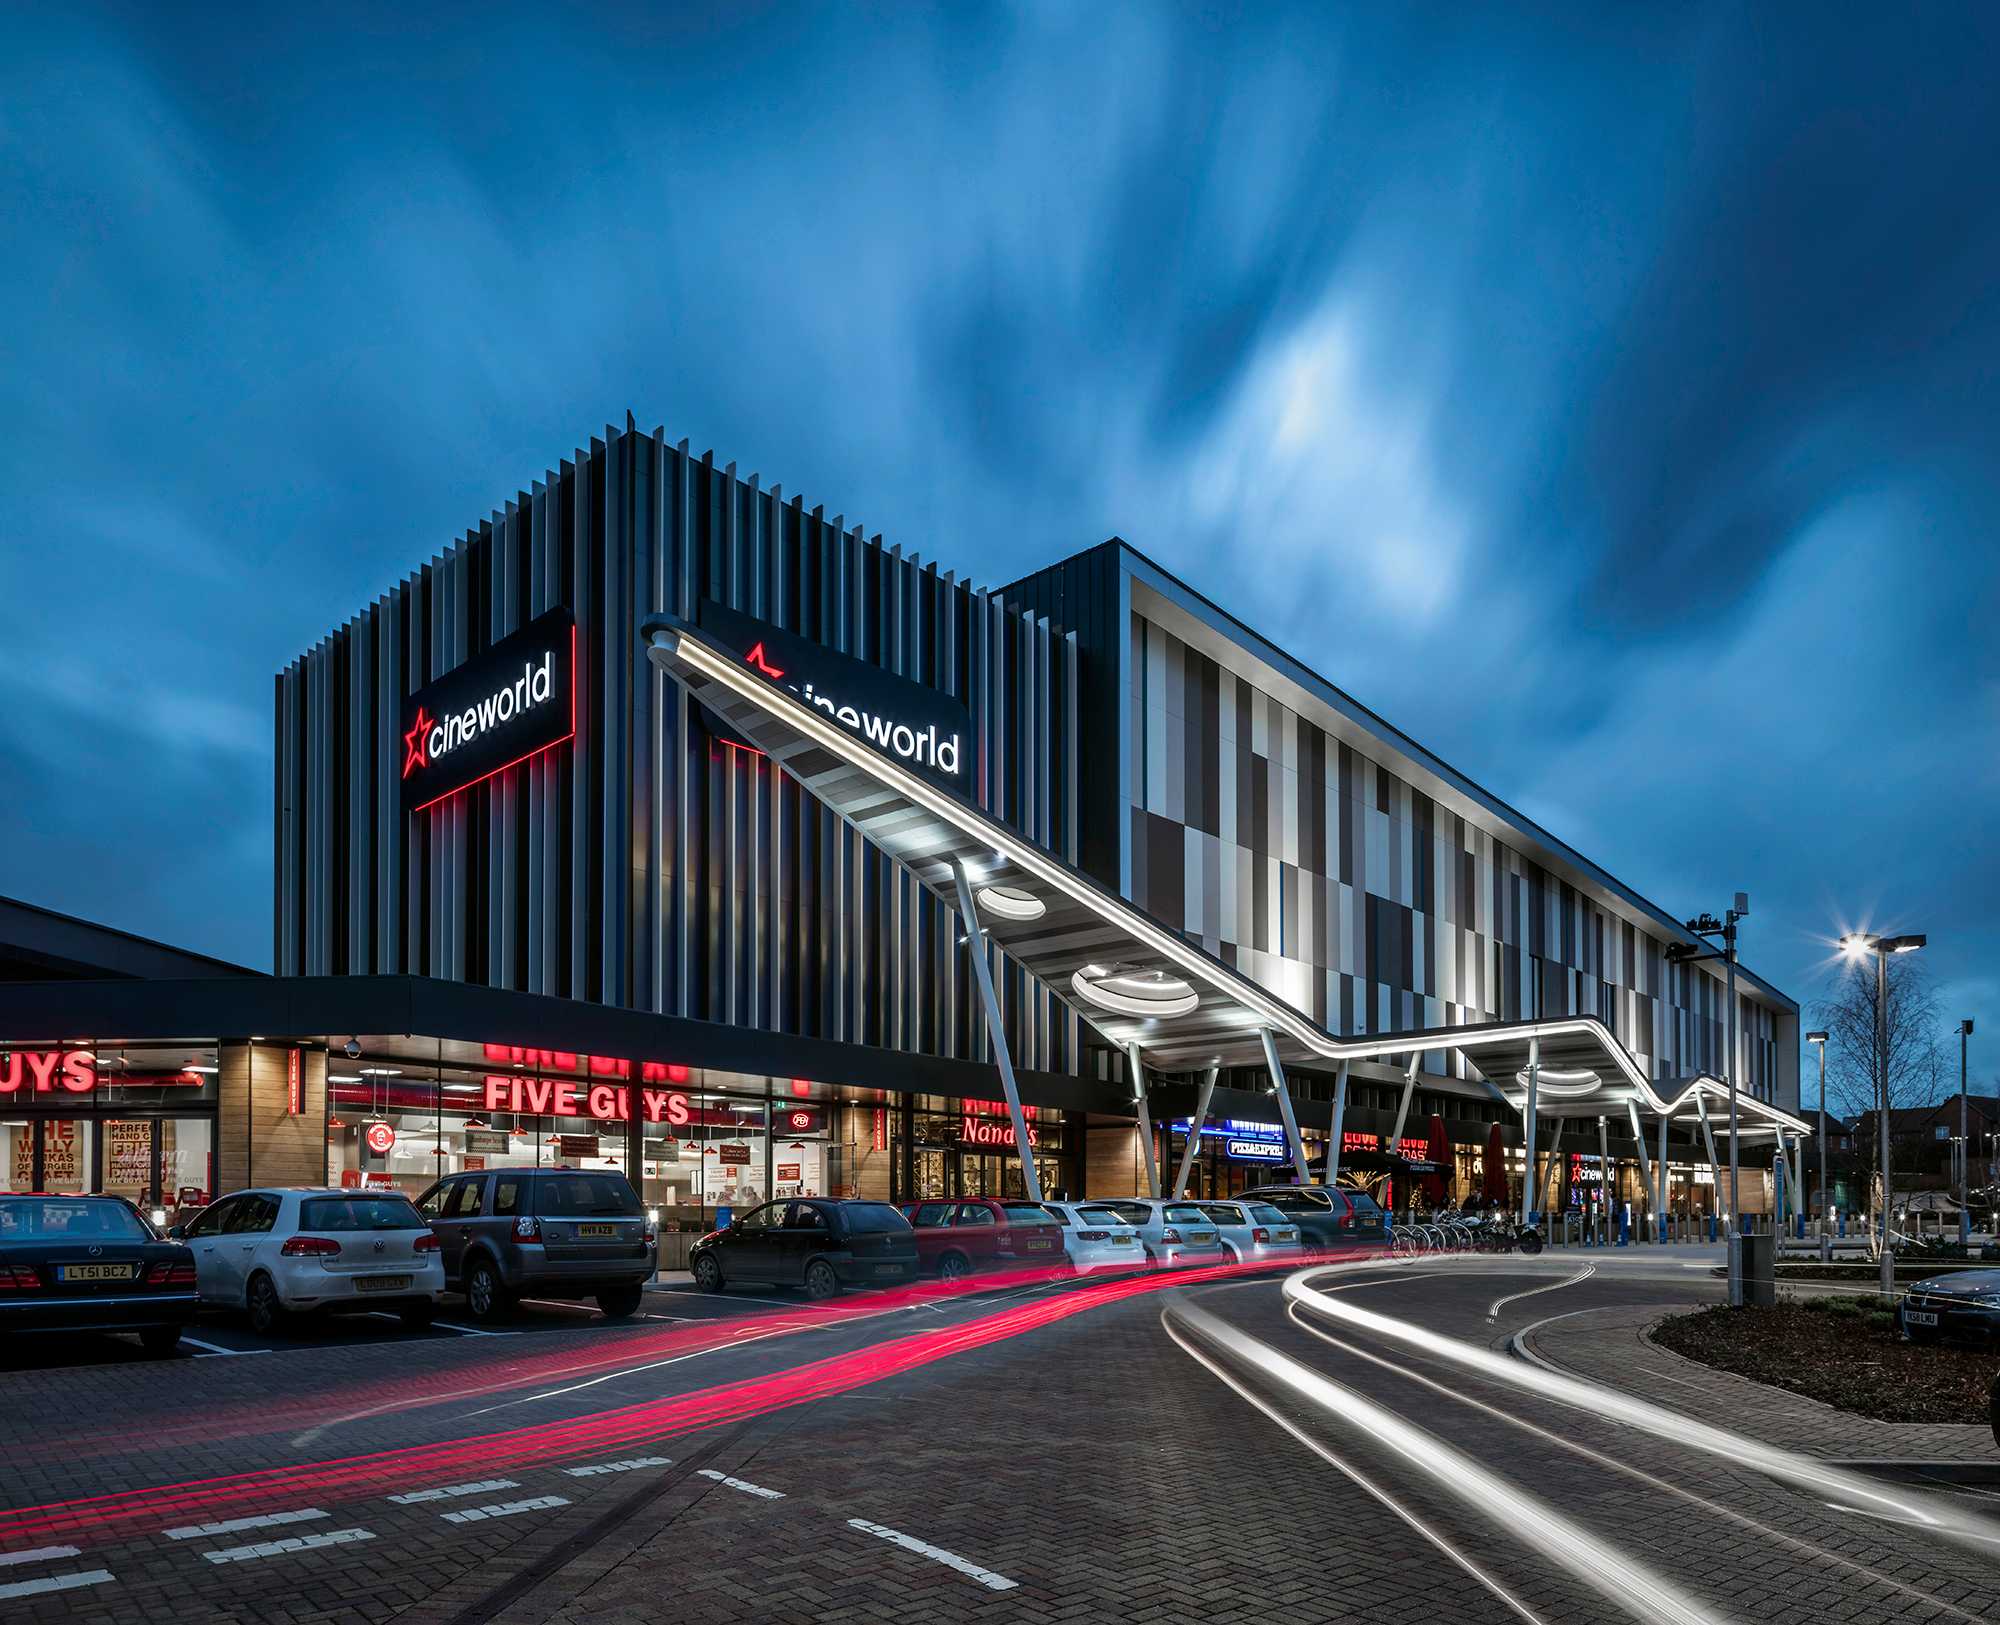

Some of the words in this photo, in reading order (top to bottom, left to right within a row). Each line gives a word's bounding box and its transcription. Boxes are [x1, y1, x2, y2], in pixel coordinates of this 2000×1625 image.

[430, 651, 551, 758] cineworld
[788, 684, 959, 774] eworld
[486, 1075, 577, 1116] FIVE
[963, 1117, 1037, 1146] Nand's
[18, 1141, 74, 1152] WLY
[17, 1153, 75, 1163] WKAS
[43, 1163, 75, 1171] RGER
[1580, 1166, 1615, 1181] cinewld
[69, 1267, 99, 1278] LT51
[103, 1266, 127, 1277] BCZ
